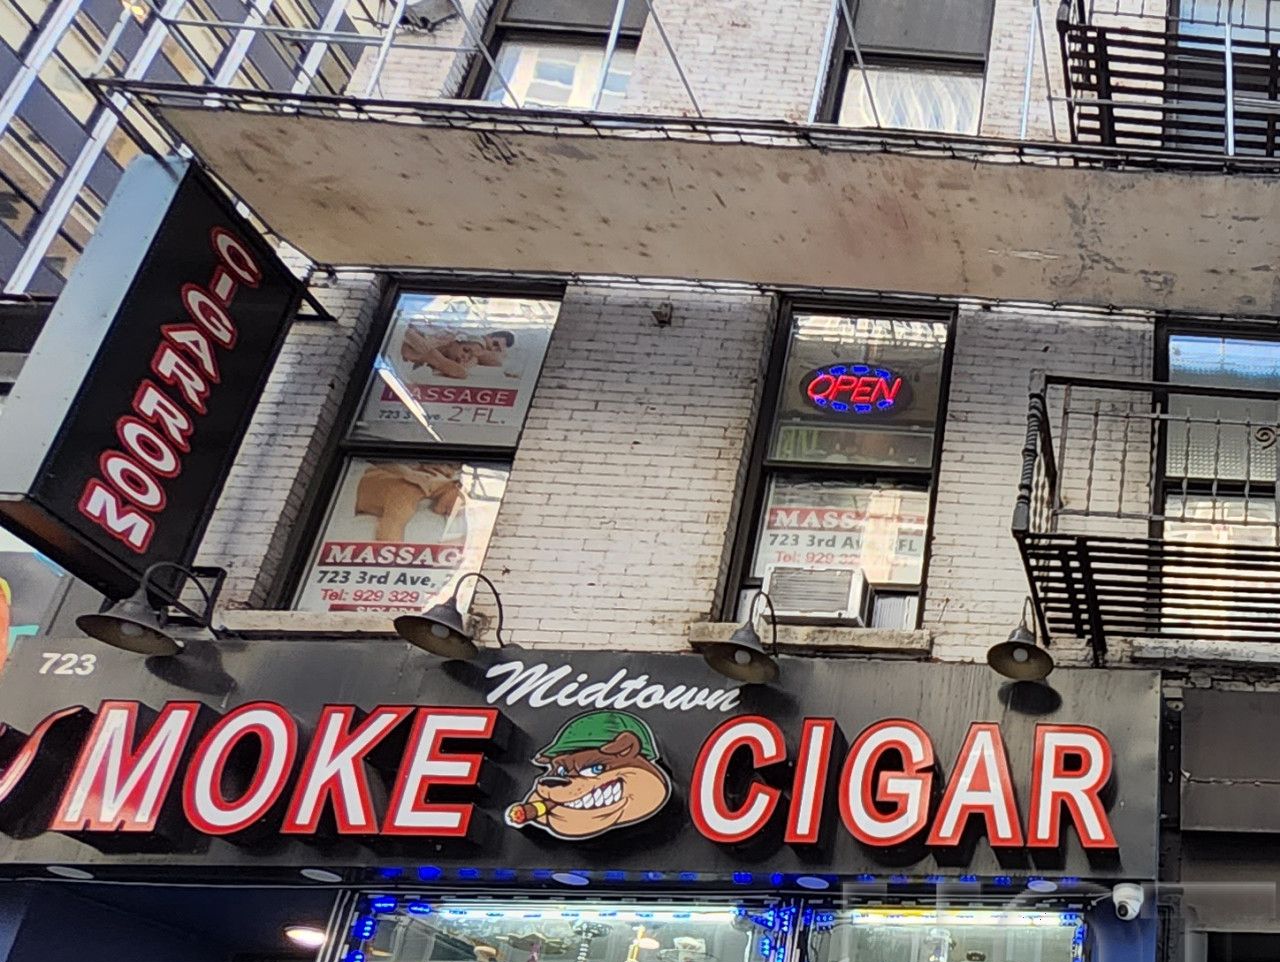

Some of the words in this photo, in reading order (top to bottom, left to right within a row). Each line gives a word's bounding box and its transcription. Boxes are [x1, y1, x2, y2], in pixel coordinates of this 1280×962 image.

[807, 374, 902, 403] OPEN
[78, 378, 194, 553] ROOM
[769, 533, 799, 547] 723
[806, 533, 836, 548] 3rd
[325, 545, 465, 568] MASSAG
[317, 570, 351, 584] 723
[356, 571, 390, 585] 3rd
[321, 588, 348, 601] Tel:
[352, 589, 384, 602] 929
[388, 590, 420, 603] 329
[38, 652, 97, 676] 723
[485, 660, 741, 712] Midtown
[689, 715, 1117, 848] CIGAR
